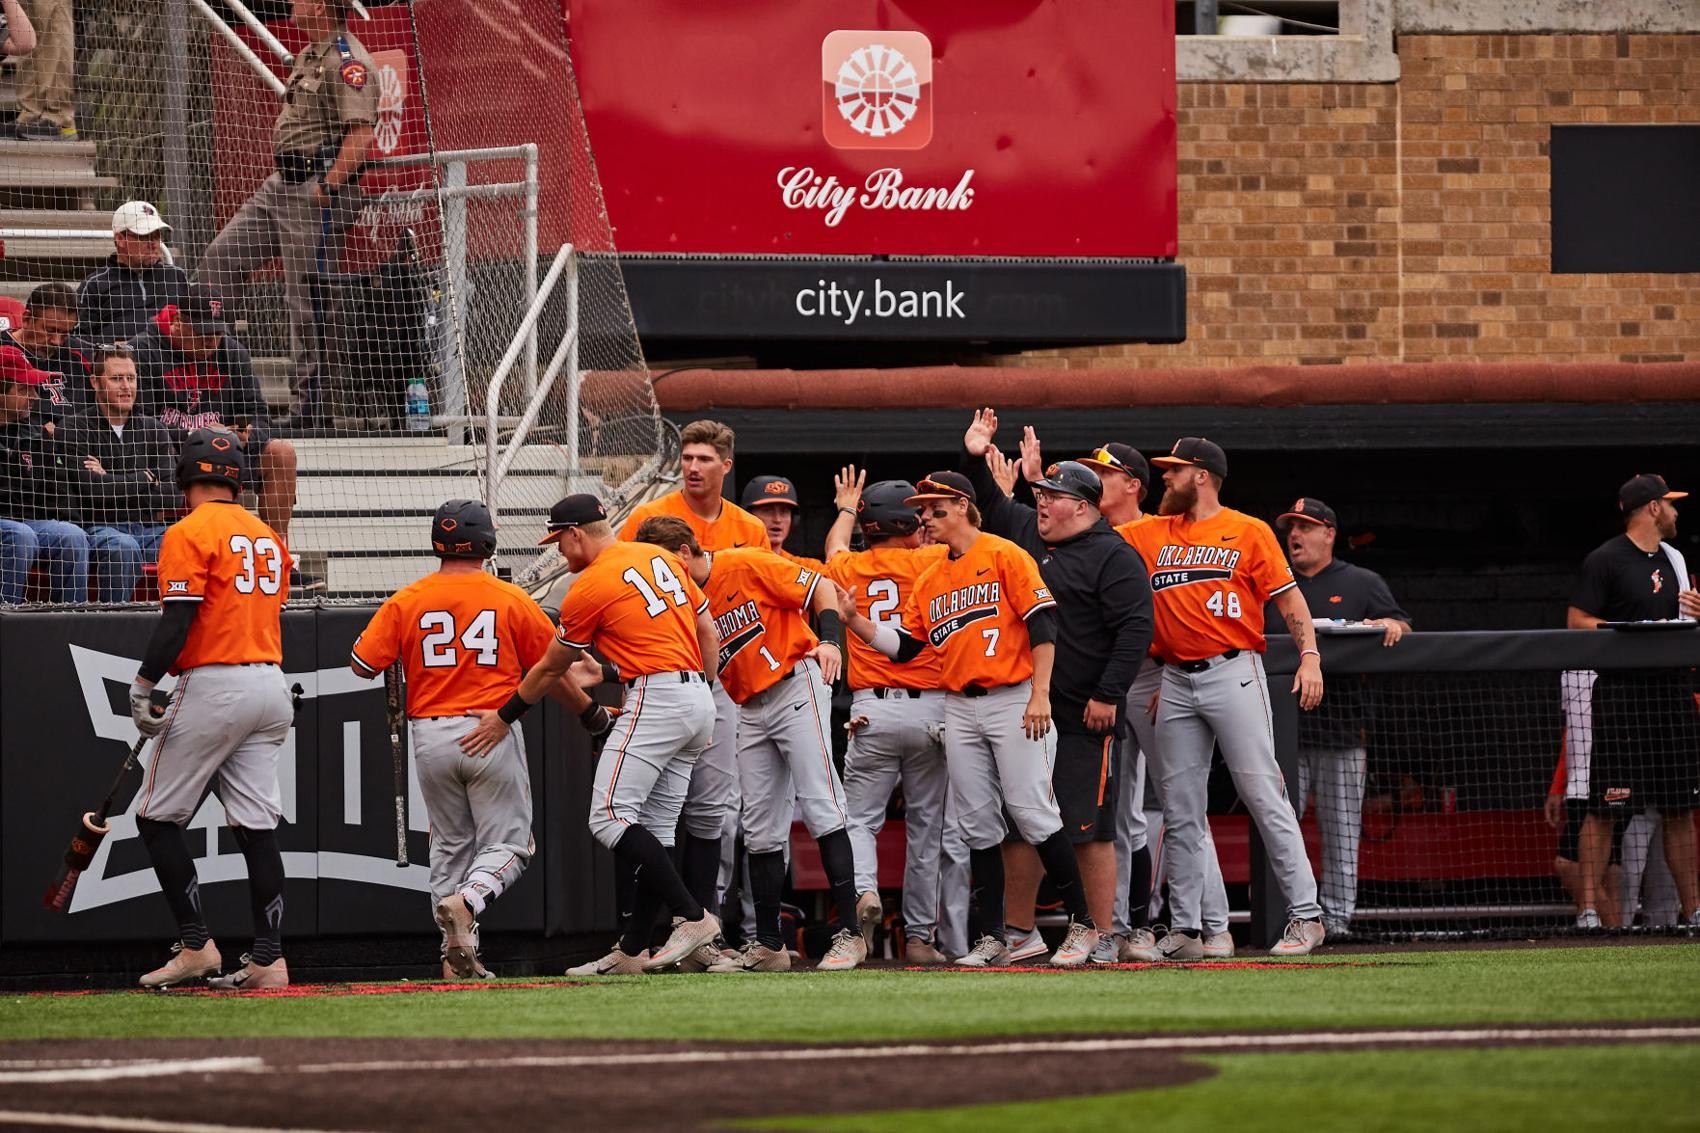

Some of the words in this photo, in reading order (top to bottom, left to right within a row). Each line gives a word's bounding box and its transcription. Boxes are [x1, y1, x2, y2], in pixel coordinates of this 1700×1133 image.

[777, 166, 857, 228] City
[860, 167, 975, 211] Bank
[795, 278, 966, 325] city.bank
[229, 534, 283, 596] 33
[1156, 545, 1242, 569] OKLAHOMA
[622, 555, 689, 619] 14
[1154, 571, 1189, 587] STATE
[867, 578, 902, 632] 2
[929, 581, 1001, 624] OKLAHOMA
[1205, 590, 1243, 618] 48
[419, 609, 500, 668] 24
[932, 620, 960, 643] STATE
[982, 628, 1001, 657] 7
[759, 645, 782, 672] 1
